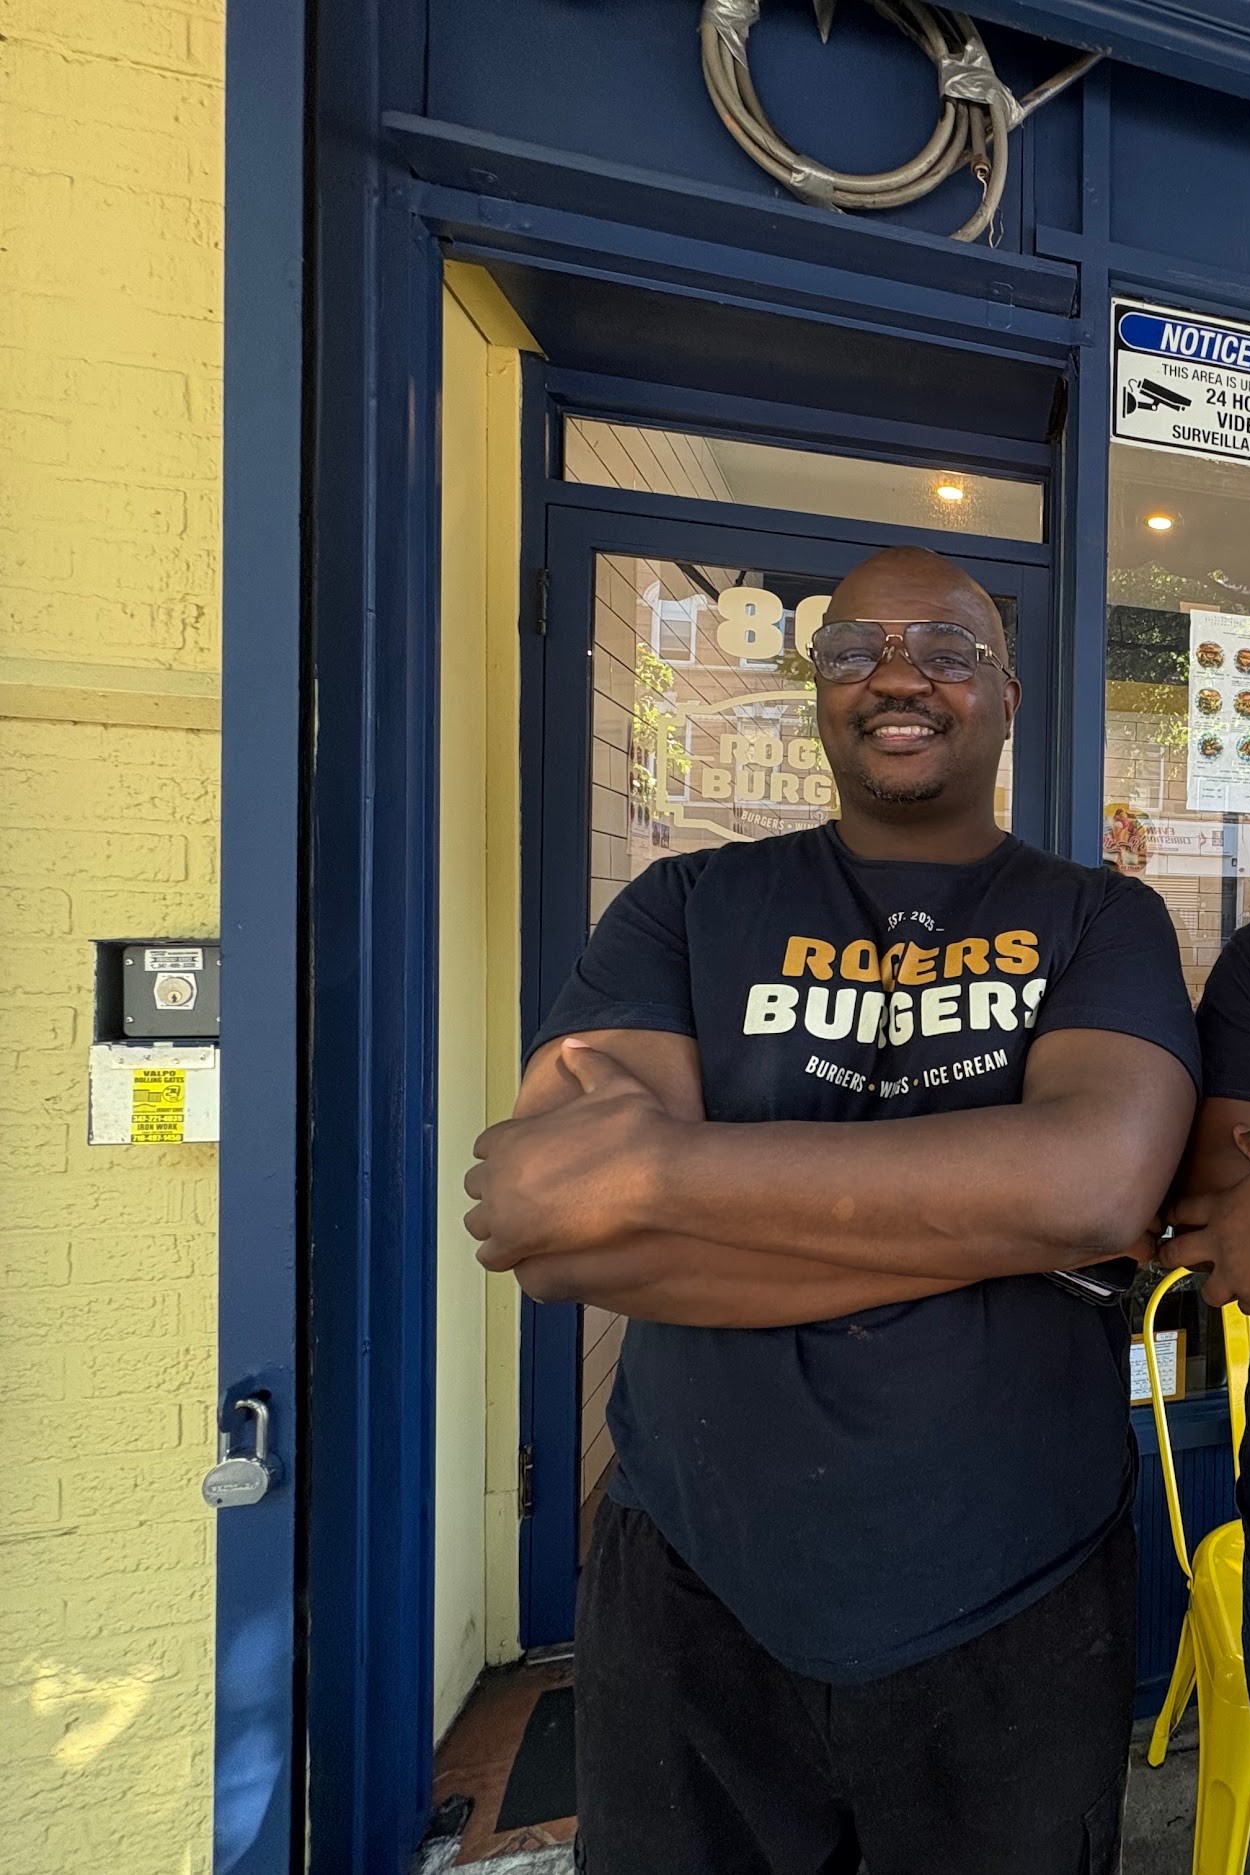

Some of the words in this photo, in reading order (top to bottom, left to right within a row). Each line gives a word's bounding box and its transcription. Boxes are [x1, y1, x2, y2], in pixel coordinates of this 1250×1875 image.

[1162, 363, 1189, 380] THIS
[1192, 369, 1222, 386] AREA
[1226, 376, 1237, 389] IS
[1206, 388, 1227, 407] 24
[720, 733, 832, 771] ROG
[702, 768, 842, 805] BURG
[740, 810, 785, 831] BURGERS
[910, 910, 936, 932] 2025
[782, 930, 1040, 992] ROGERS
[743, 978, 1047, 1049] BURGERS
[805, 1055, 866, 1093] BURGERS
[923, 1065, 949, 1088] ICE
[953, 1048, 1009, 1081] CREAM
[137, 1123, 155, 1131] IRON
